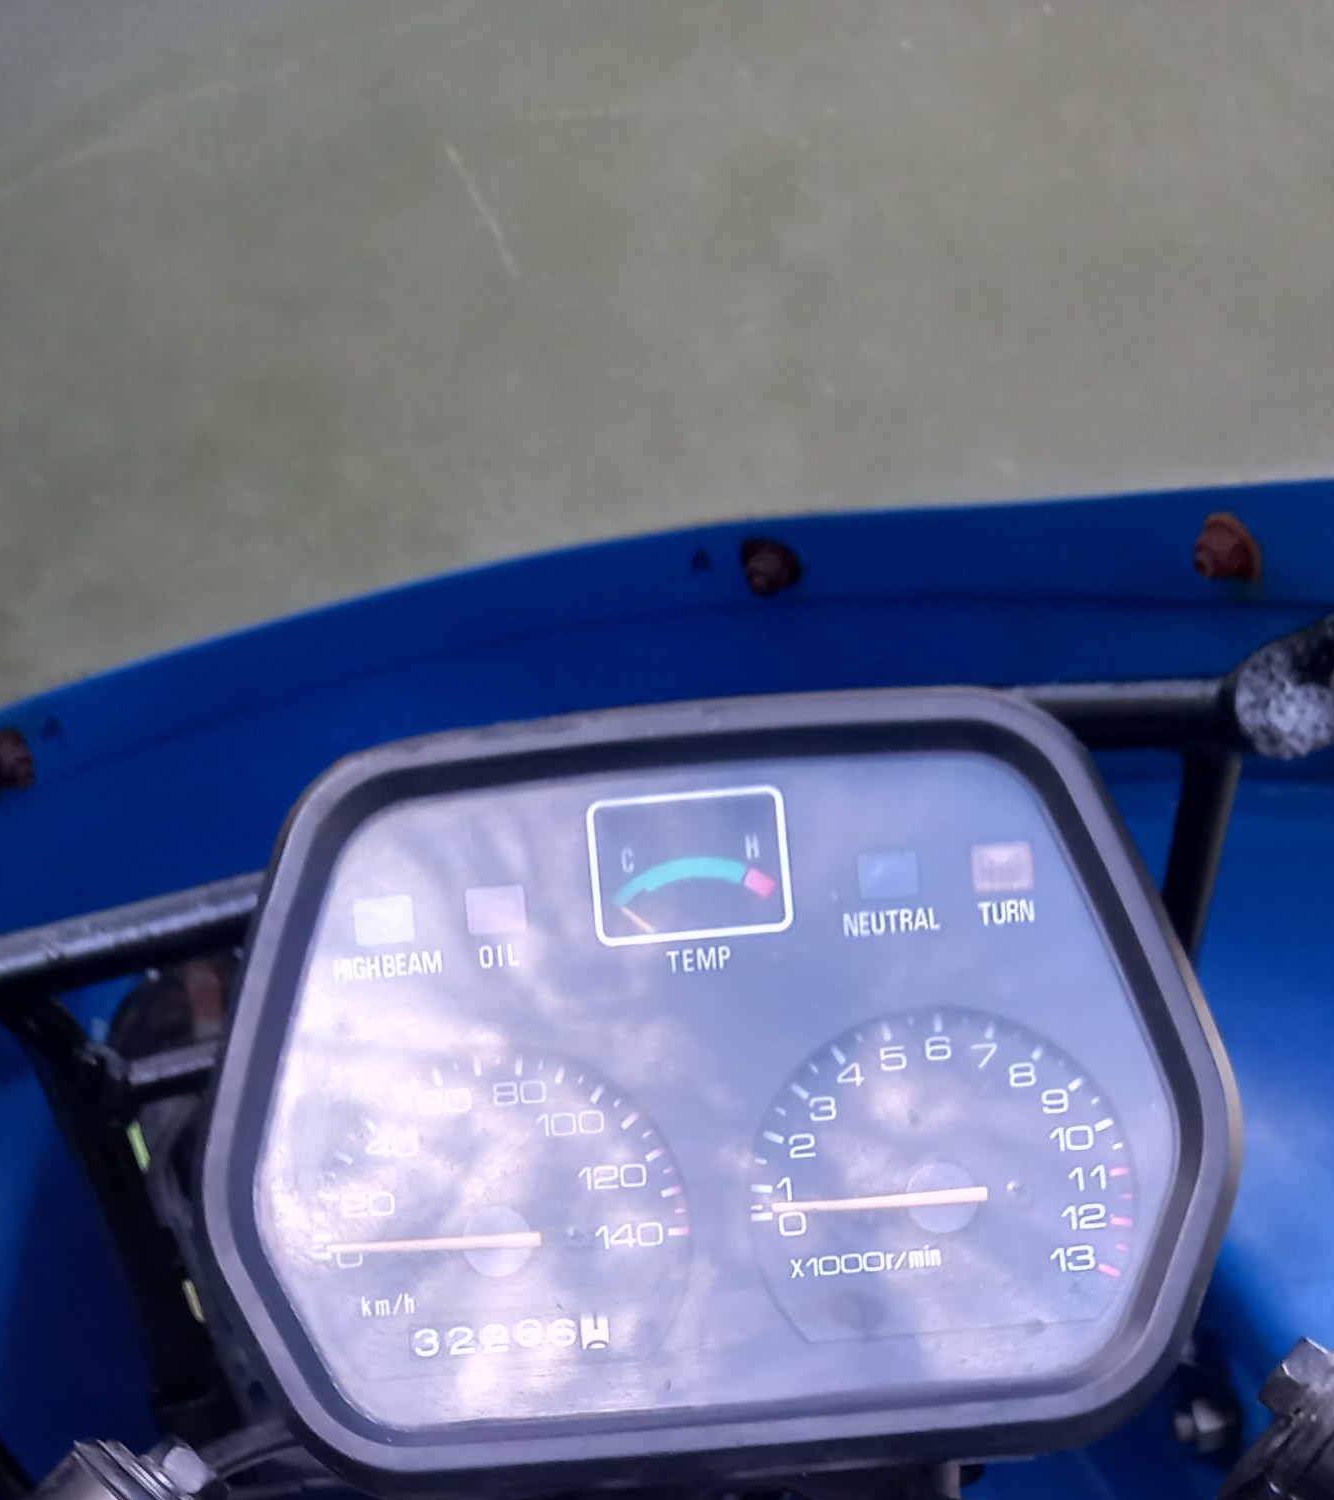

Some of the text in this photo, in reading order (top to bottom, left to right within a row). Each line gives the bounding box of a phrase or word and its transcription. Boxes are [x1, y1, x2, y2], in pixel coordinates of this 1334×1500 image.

[745, 834, 760, 859] H
[621, 847, 635, 873] C
[842, 907, 941, 938] NEUTRAL
[977, 898, 1035, 926] TURN
[478, 943, 520, 969] OIL
[666, 945, 731, 973] TEMP
[879, 1045, 907, 1071] 5
[924, 1036, 952, 1061] 6
[970, 1043, 998, 1069] 7
[836, 1062, 865, 1086] 4
[1008, 1062, 1037, 1087] 8
[492, 1079, 547, 1106] 80
[1041, 1088, 1070, 1114] 9
[808, 1096, 837, 1121] 3
[536, 1110, 605, 1137] 100
[788, 1133, 817, 1159] 2
[1049, 1125, 1094, 1152] 10
[578, 1163, 647, 1190] 120
[776, 1176, 793, 1201] 1
[1068, 1165, 1107, 1191] 11
[342, 1191, 396, 1218] 20
[1061, 1203, 1108, 1230] 12
[595, 1222, 664, 1249] 140
[778, 1211, 807, 1236] 0
[1050, 1245, 1096, 1272] 13
[360, 1292, 416, 1317] km/h
